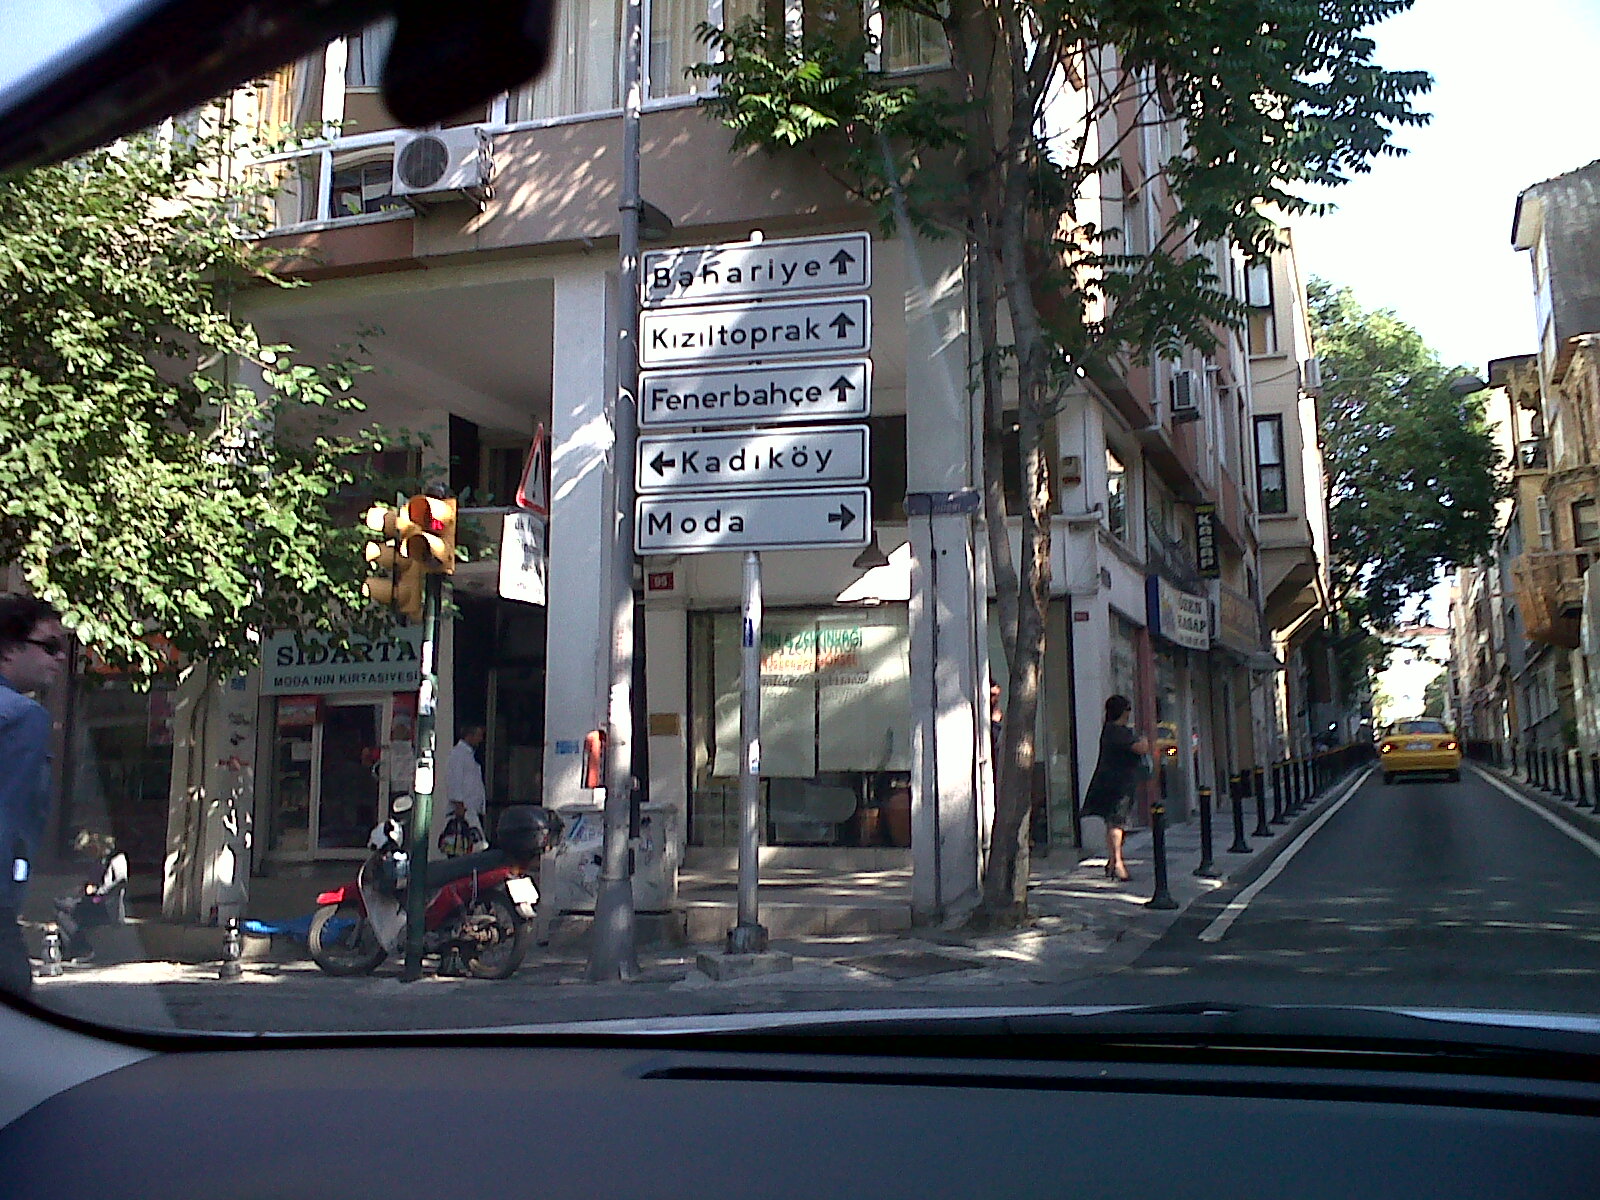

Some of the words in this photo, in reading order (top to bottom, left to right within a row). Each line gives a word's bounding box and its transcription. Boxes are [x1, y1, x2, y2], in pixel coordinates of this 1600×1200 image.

[652, 257, 822, 289] Bahariye
[652, 317, 821, 350] Kızıltoprak
[652, 382, 822, 412] Fenerbahçe
[681, 445, 833, 474] Kadıköy
[648, 510, 745, 536] Moda
